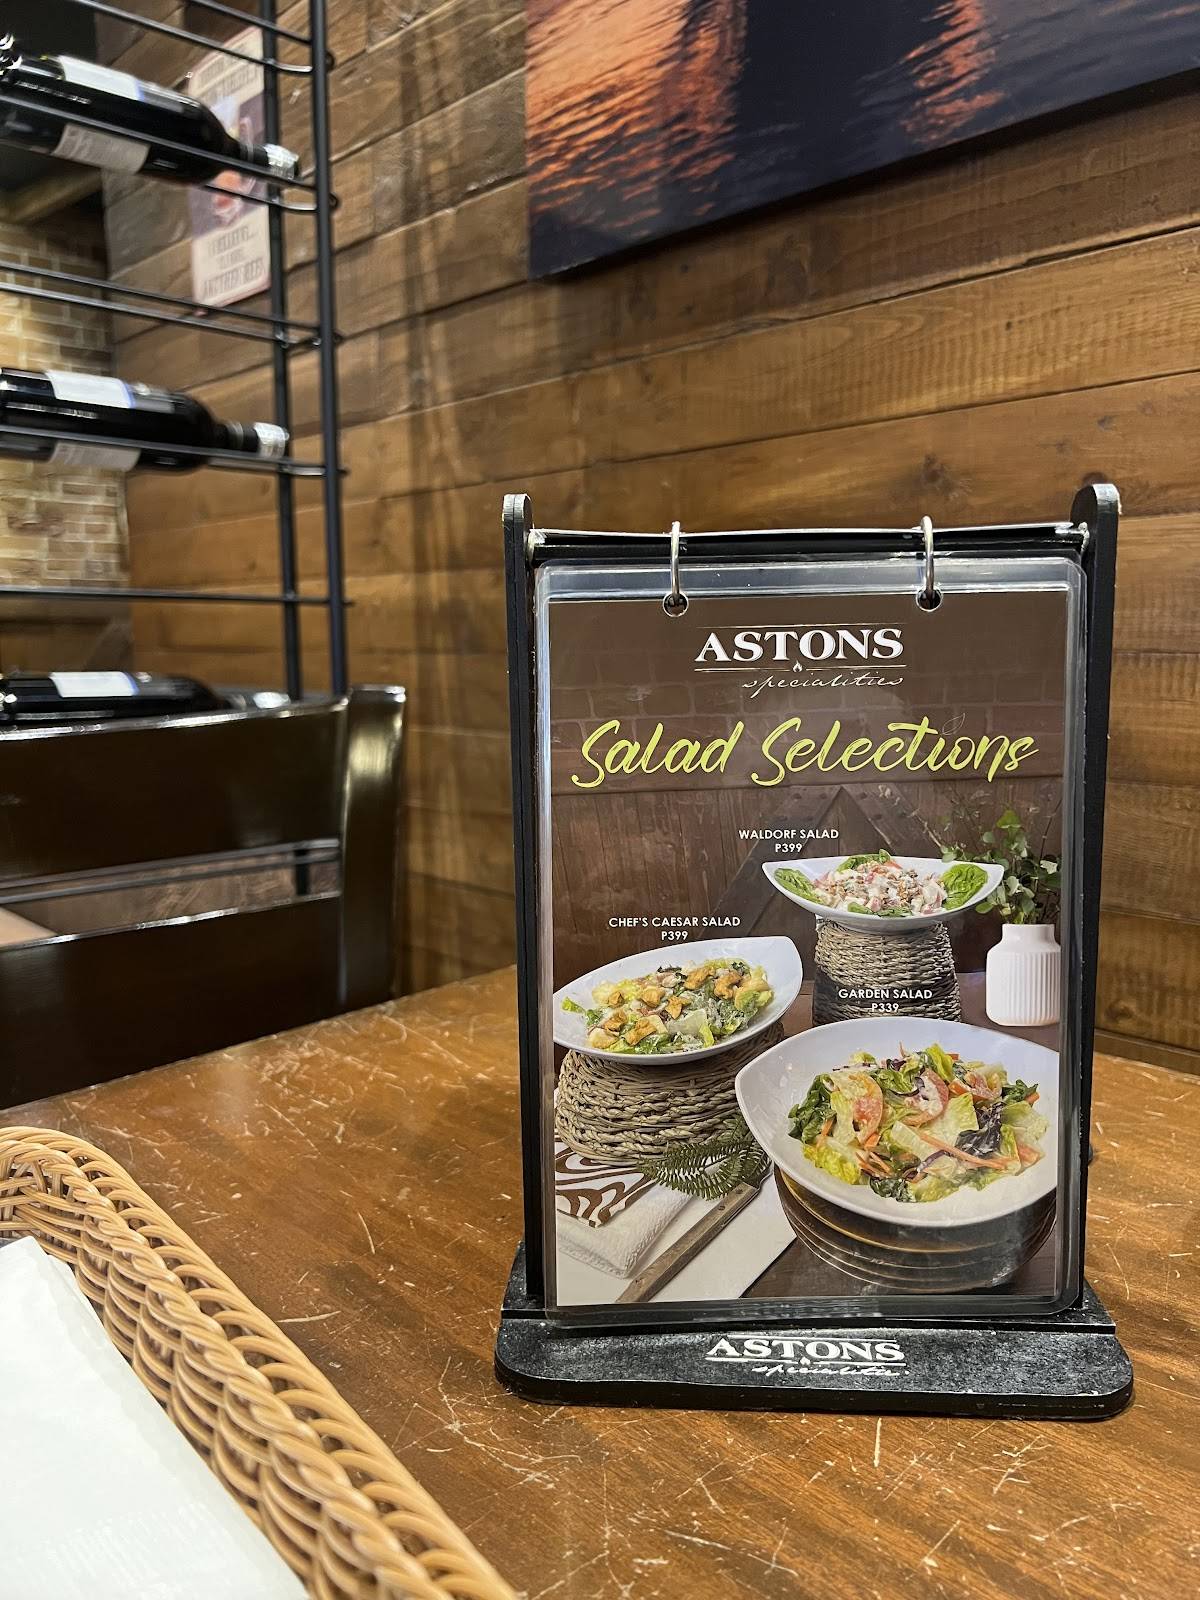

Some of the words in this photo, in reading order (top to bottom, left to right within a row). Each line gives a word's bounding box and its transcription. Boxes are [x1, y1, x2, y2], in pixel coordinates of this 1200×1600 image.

[694, 628, 904, 662] ASTONS
[741, 671, 904, 699] specialities
[571, 719, 745, 789] Salad
[750, 716, 1040, 786] Selections
[738, 829, 797, 840] WALDORF
[799, 829, 840, 839] SALAD
[774, 843, 803, 853] P399
[608, 917, 649, 928] CHEF'S
[651, 917, 699, 927] CAESAR
[702, 916, 741, 927] SALAD
[661, 931, 689, 941] P399
[838, 989, 890, 999] GARDEN
[892, 989, 933, 999] SALAD
[871, 1002, 900, 1013] P339
[706, 1338, 905, 1361] ASTONS
